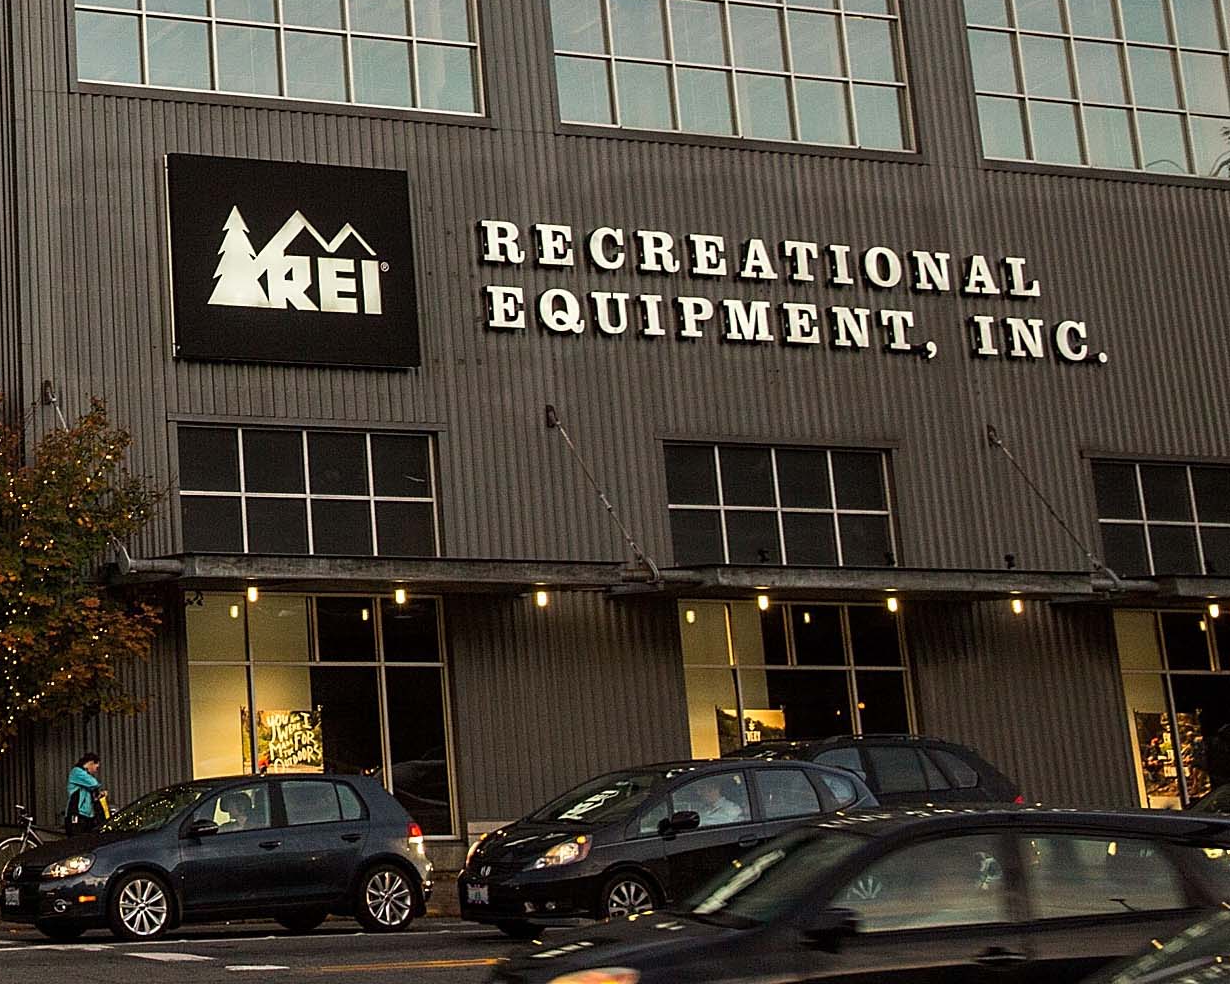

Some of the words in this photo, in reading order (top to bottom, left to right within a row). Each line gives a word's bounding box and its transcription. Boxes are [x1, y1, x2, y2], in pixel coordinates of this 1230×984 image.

[480, 219, 1041, 297] RECREATIONAL
[267, 254, 383, 315] REI
[486, 285, 937, 359] EQUIPMENT,
[973, 315, 1108, 363] INC.
[266, 714, 289, 743] YOU
[294, 729, 317, 751] FOR
[274, 744, 323, 773] OUTDOORS
